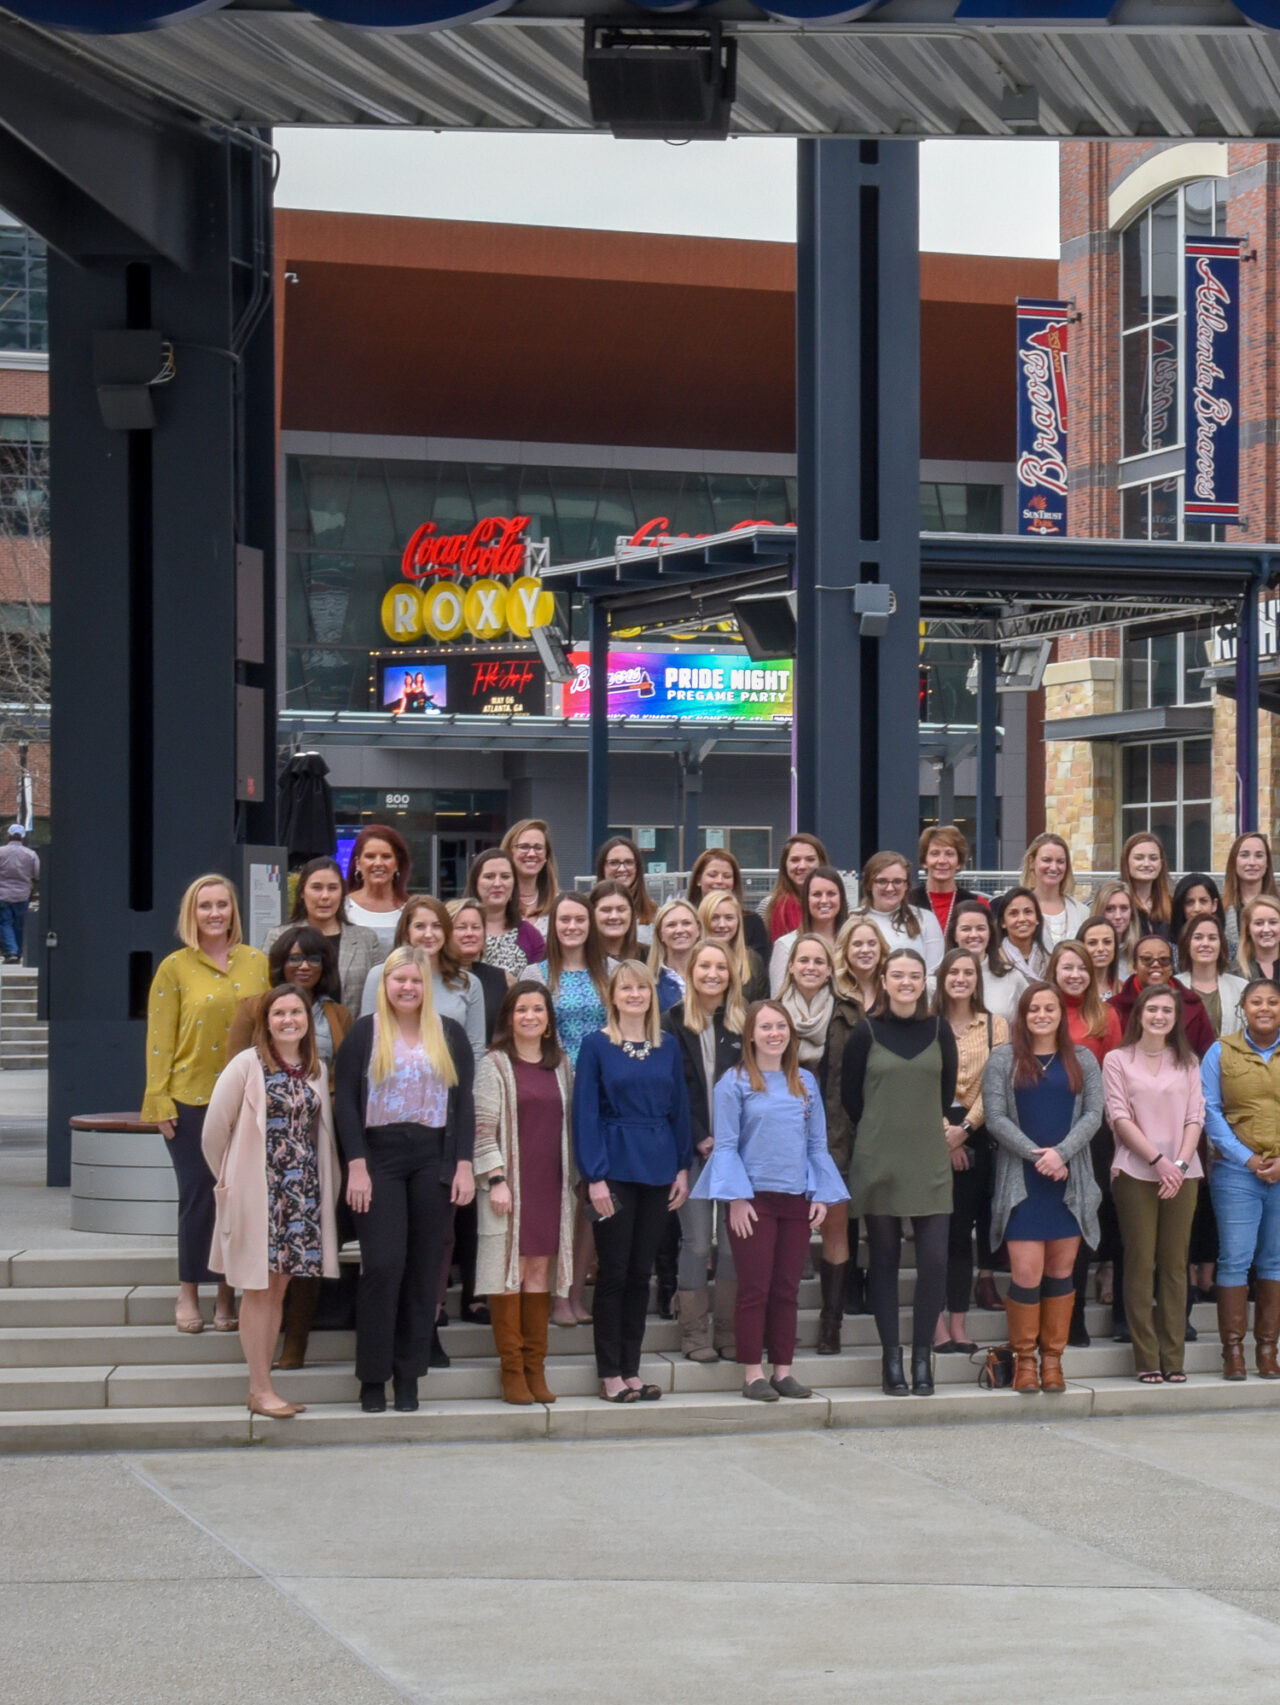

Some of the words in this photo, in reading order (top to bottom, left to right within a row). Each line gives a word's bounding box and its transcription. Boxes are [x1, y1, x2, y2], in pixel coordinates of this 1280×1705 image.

[1196, 258, 1230, 390] Atlanta
[1017, 349, 1068, 496] Braves
[1194, 386, 1232, 502] Braves
[402, 515, 532, 579] Coca-Cola
[394, 587, 541, 633] ROXY
[570, 663, 643, 695] Baves
[665, 667, 724, 689] PRIDE
[730, 669, 790, 691] NIGHT
[667, 690, 735, 702] PREGAME
[740, 691, 786, 703] PARTY
[386, 794, 410, 804] 800
